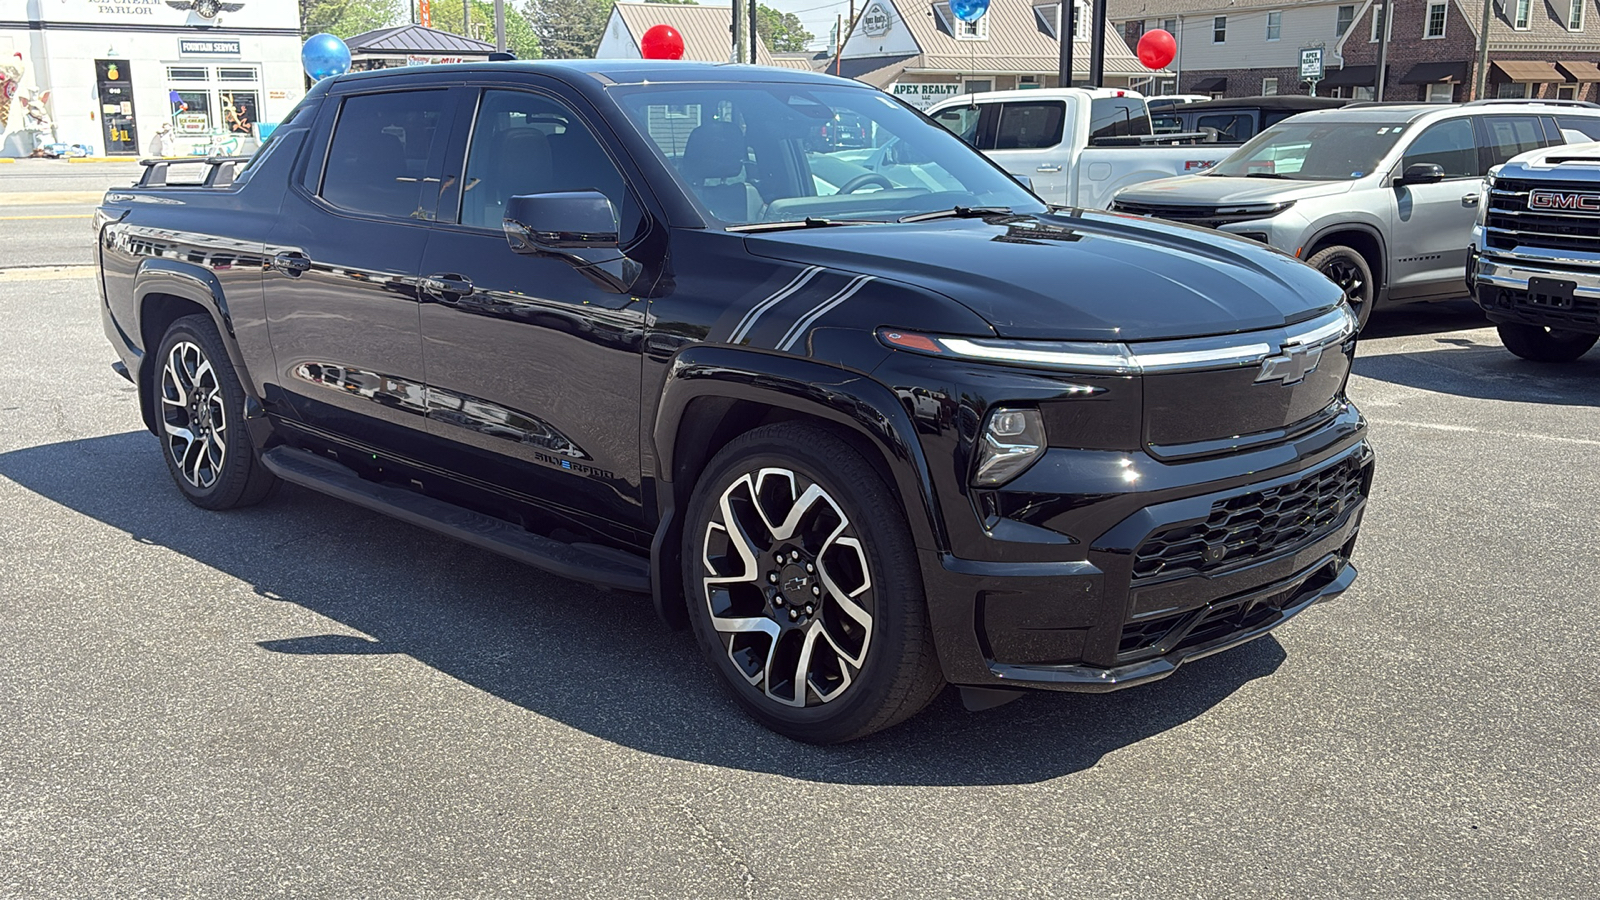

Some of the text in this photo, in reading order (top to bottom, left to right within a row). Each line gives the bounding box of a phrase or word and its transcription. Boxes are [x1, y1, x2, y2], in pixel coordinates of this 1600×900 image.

[98, 5, 153, 15] PARLOR
[183, 42, 239, 53] FOUNTAIN SERVICE
[893, 85, 958, 94] APEX REALTY
[1532, 192, 1600, 210] GMC
[534, 451, 615, 479] SILVERADO
